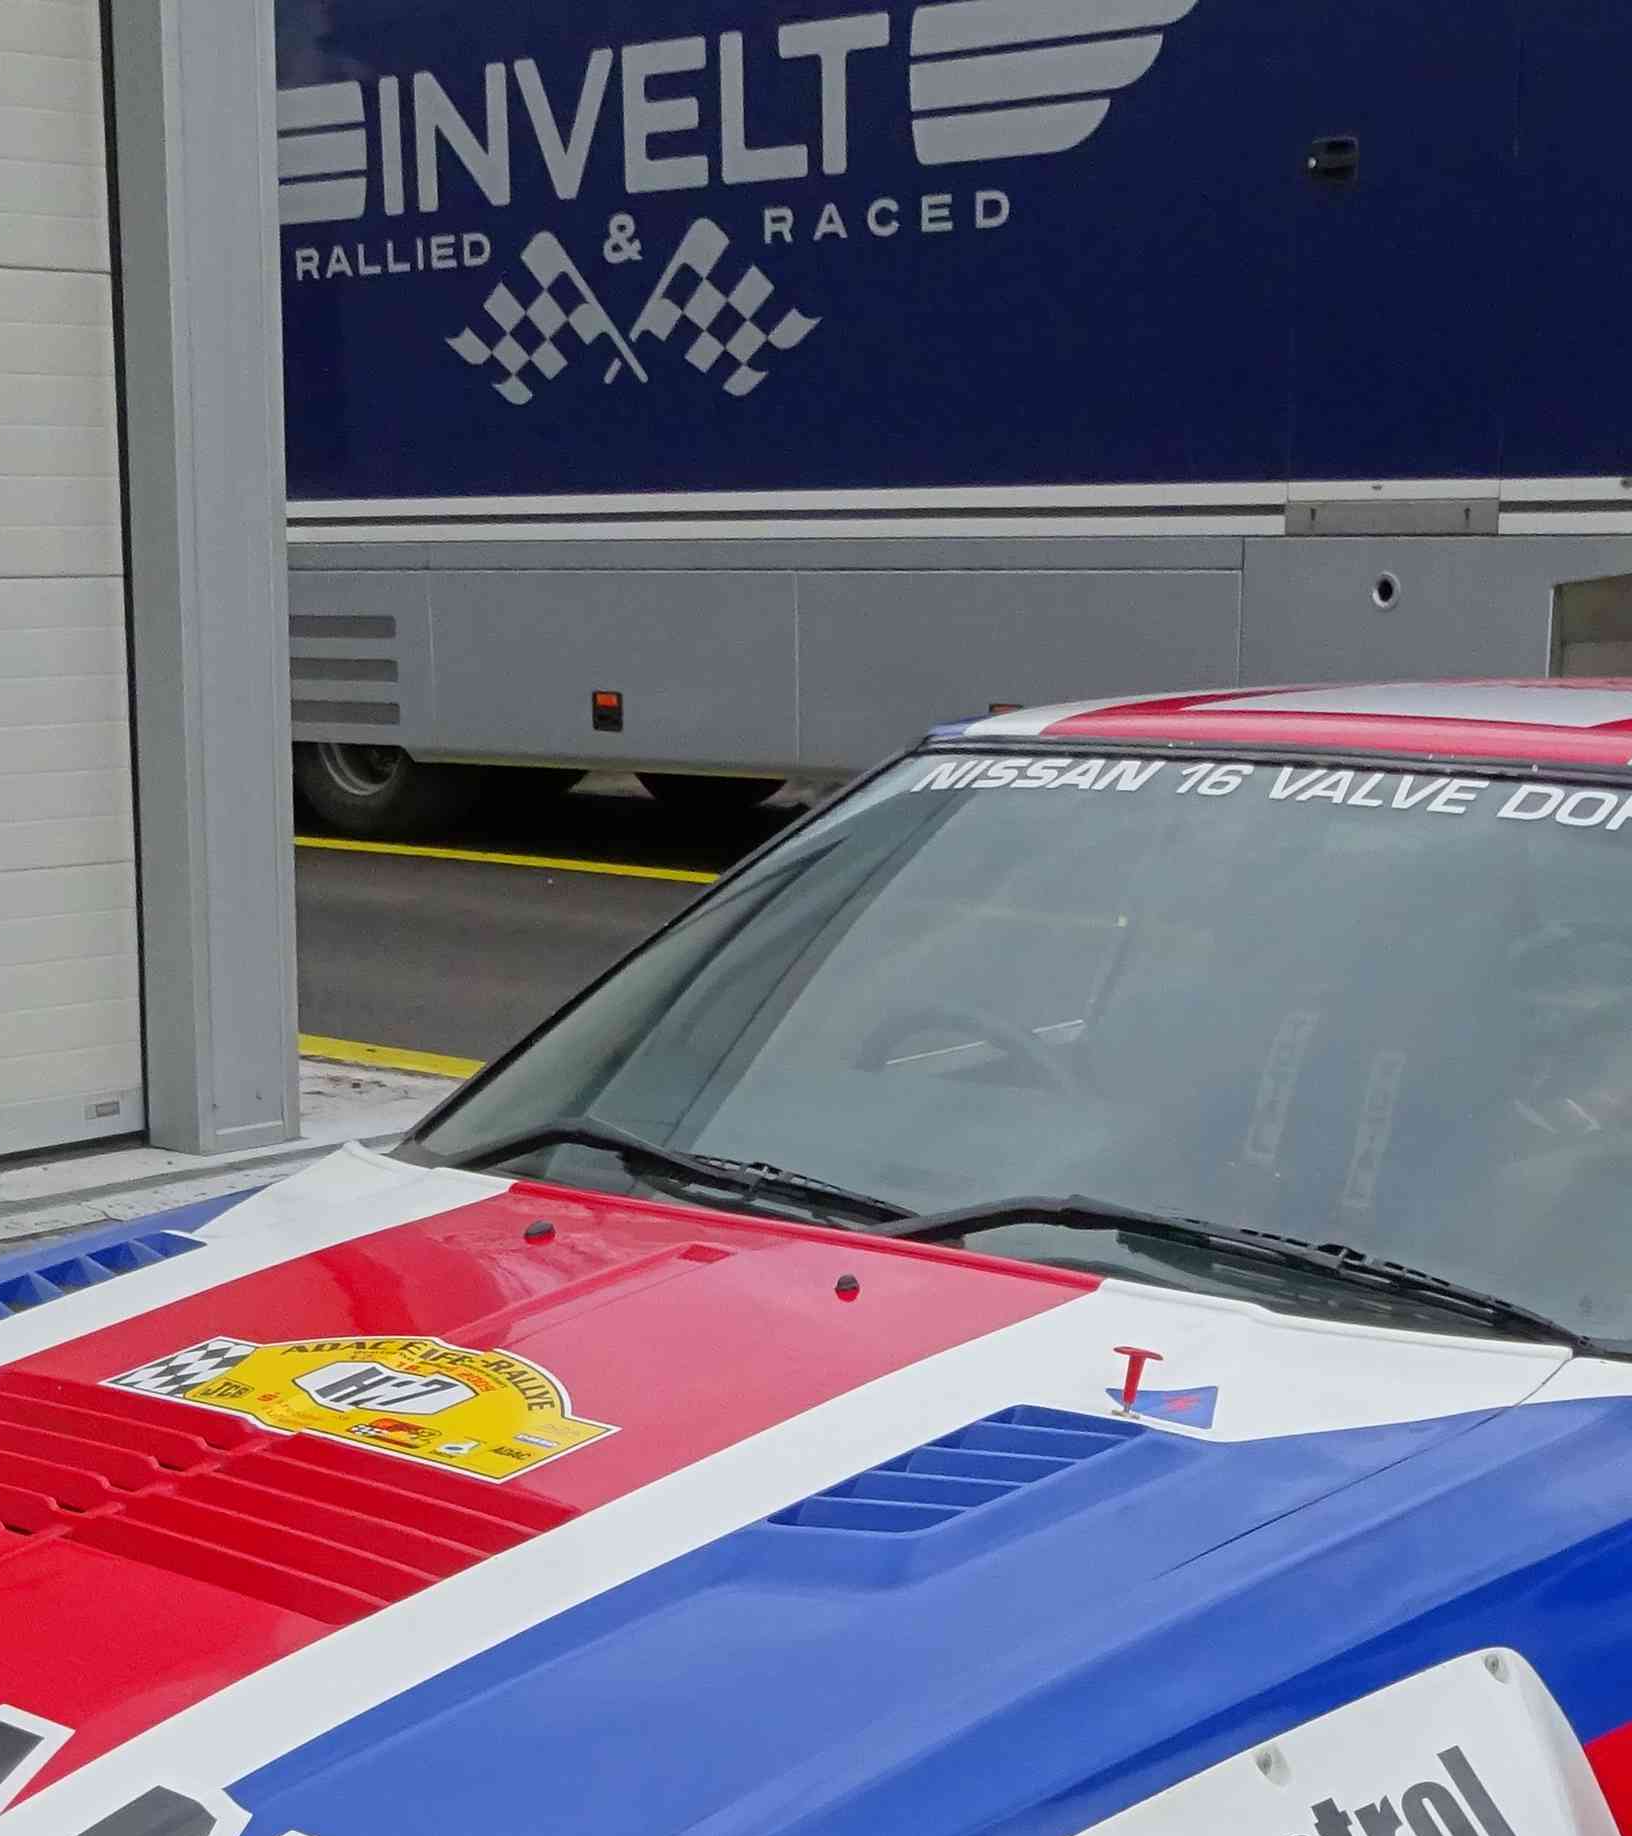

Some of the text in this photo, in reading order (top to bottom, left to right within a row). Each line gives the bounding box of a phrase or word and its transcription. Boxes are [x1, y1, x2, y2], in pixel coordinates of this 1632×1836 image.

[378, 12, 890, 216] INVELT
[295, 190, 1011, 282] RALLIED & RACED
[910, 759, 1166, 793] NISSAN
[1177, 761, 1254, 797] 16
[1268, 766, 1499, 815] VALVE
[280, 1341, 398, 1355] ADAC
